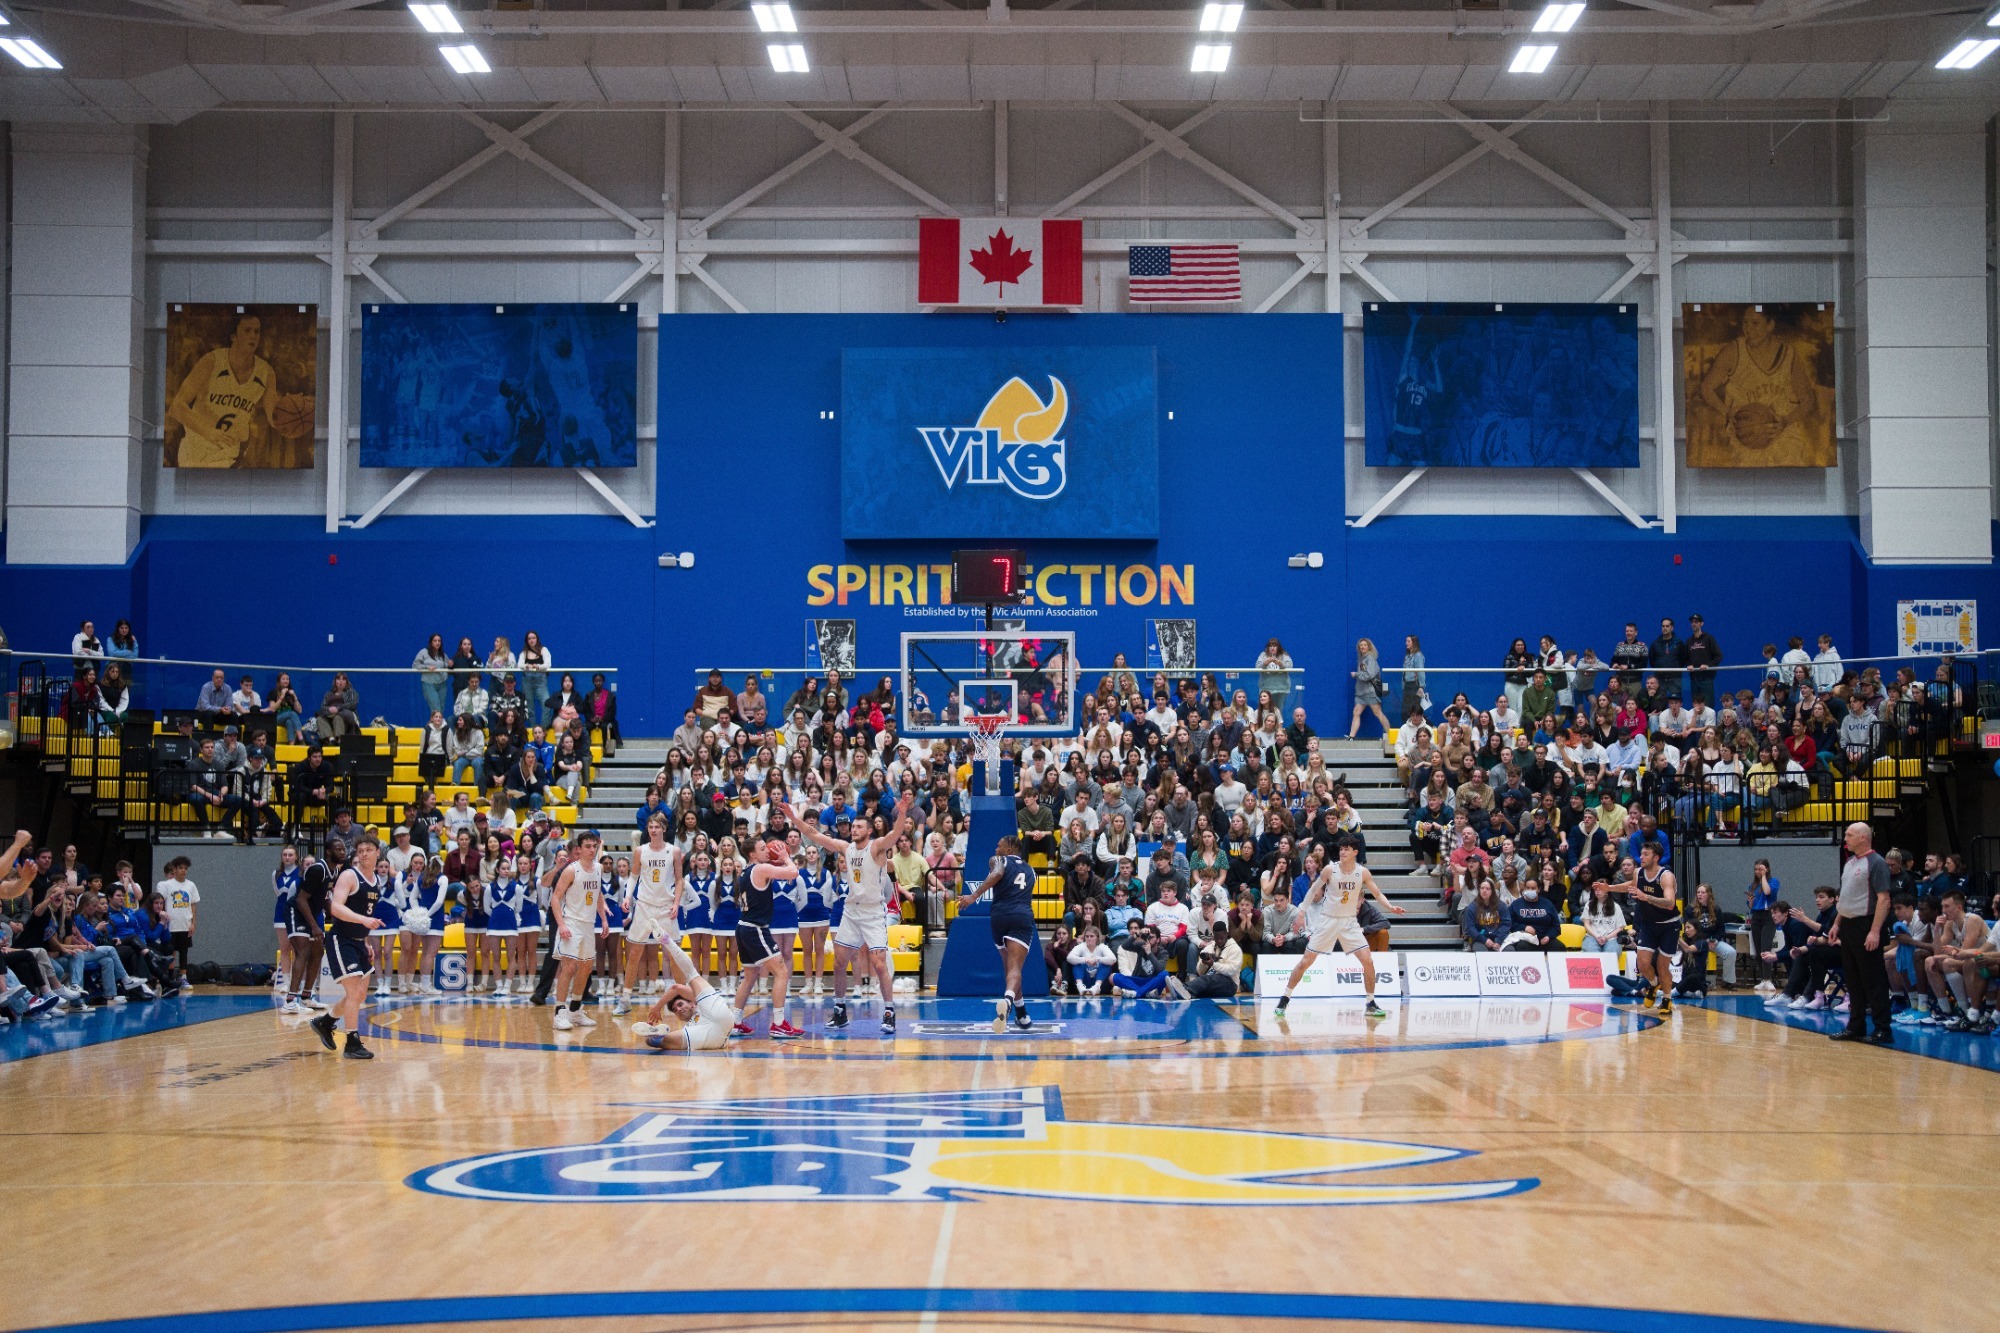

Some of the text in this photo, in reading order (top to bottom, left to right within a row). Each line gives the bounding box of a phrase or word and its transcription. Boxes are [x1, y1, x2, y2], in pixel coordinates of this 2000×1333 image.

[916, 427, 1067, 499] Vikes
[992, 557, 1010, 593] 7
[807, 564, 952, 606] SPIRIT
[1025, 564, 1195, 606] CTION
[904, 607, 955, 616] Established
[958, 607, 968, 619] by
[971, 607, 986, 616] the
[1011, 607, 1043, 616] Alumni
[1046, 607, 1098, 616] Association
[648, 859, 666, 867] VIKES
[652, 869, 660, 882] 2
[1013, 872, 1027, 889] 4
[583, 880, 598, 890] VIKES
[1338, 881, 1356, 890] VIKES
[1341, 891, 1350, 904] 3
[366, 903, 374, 914] 3
[440, 954, 466, 989] S
[1487, 966, 1520, 975] STICKY
[1487, 976, 1521, 984] WICKET
